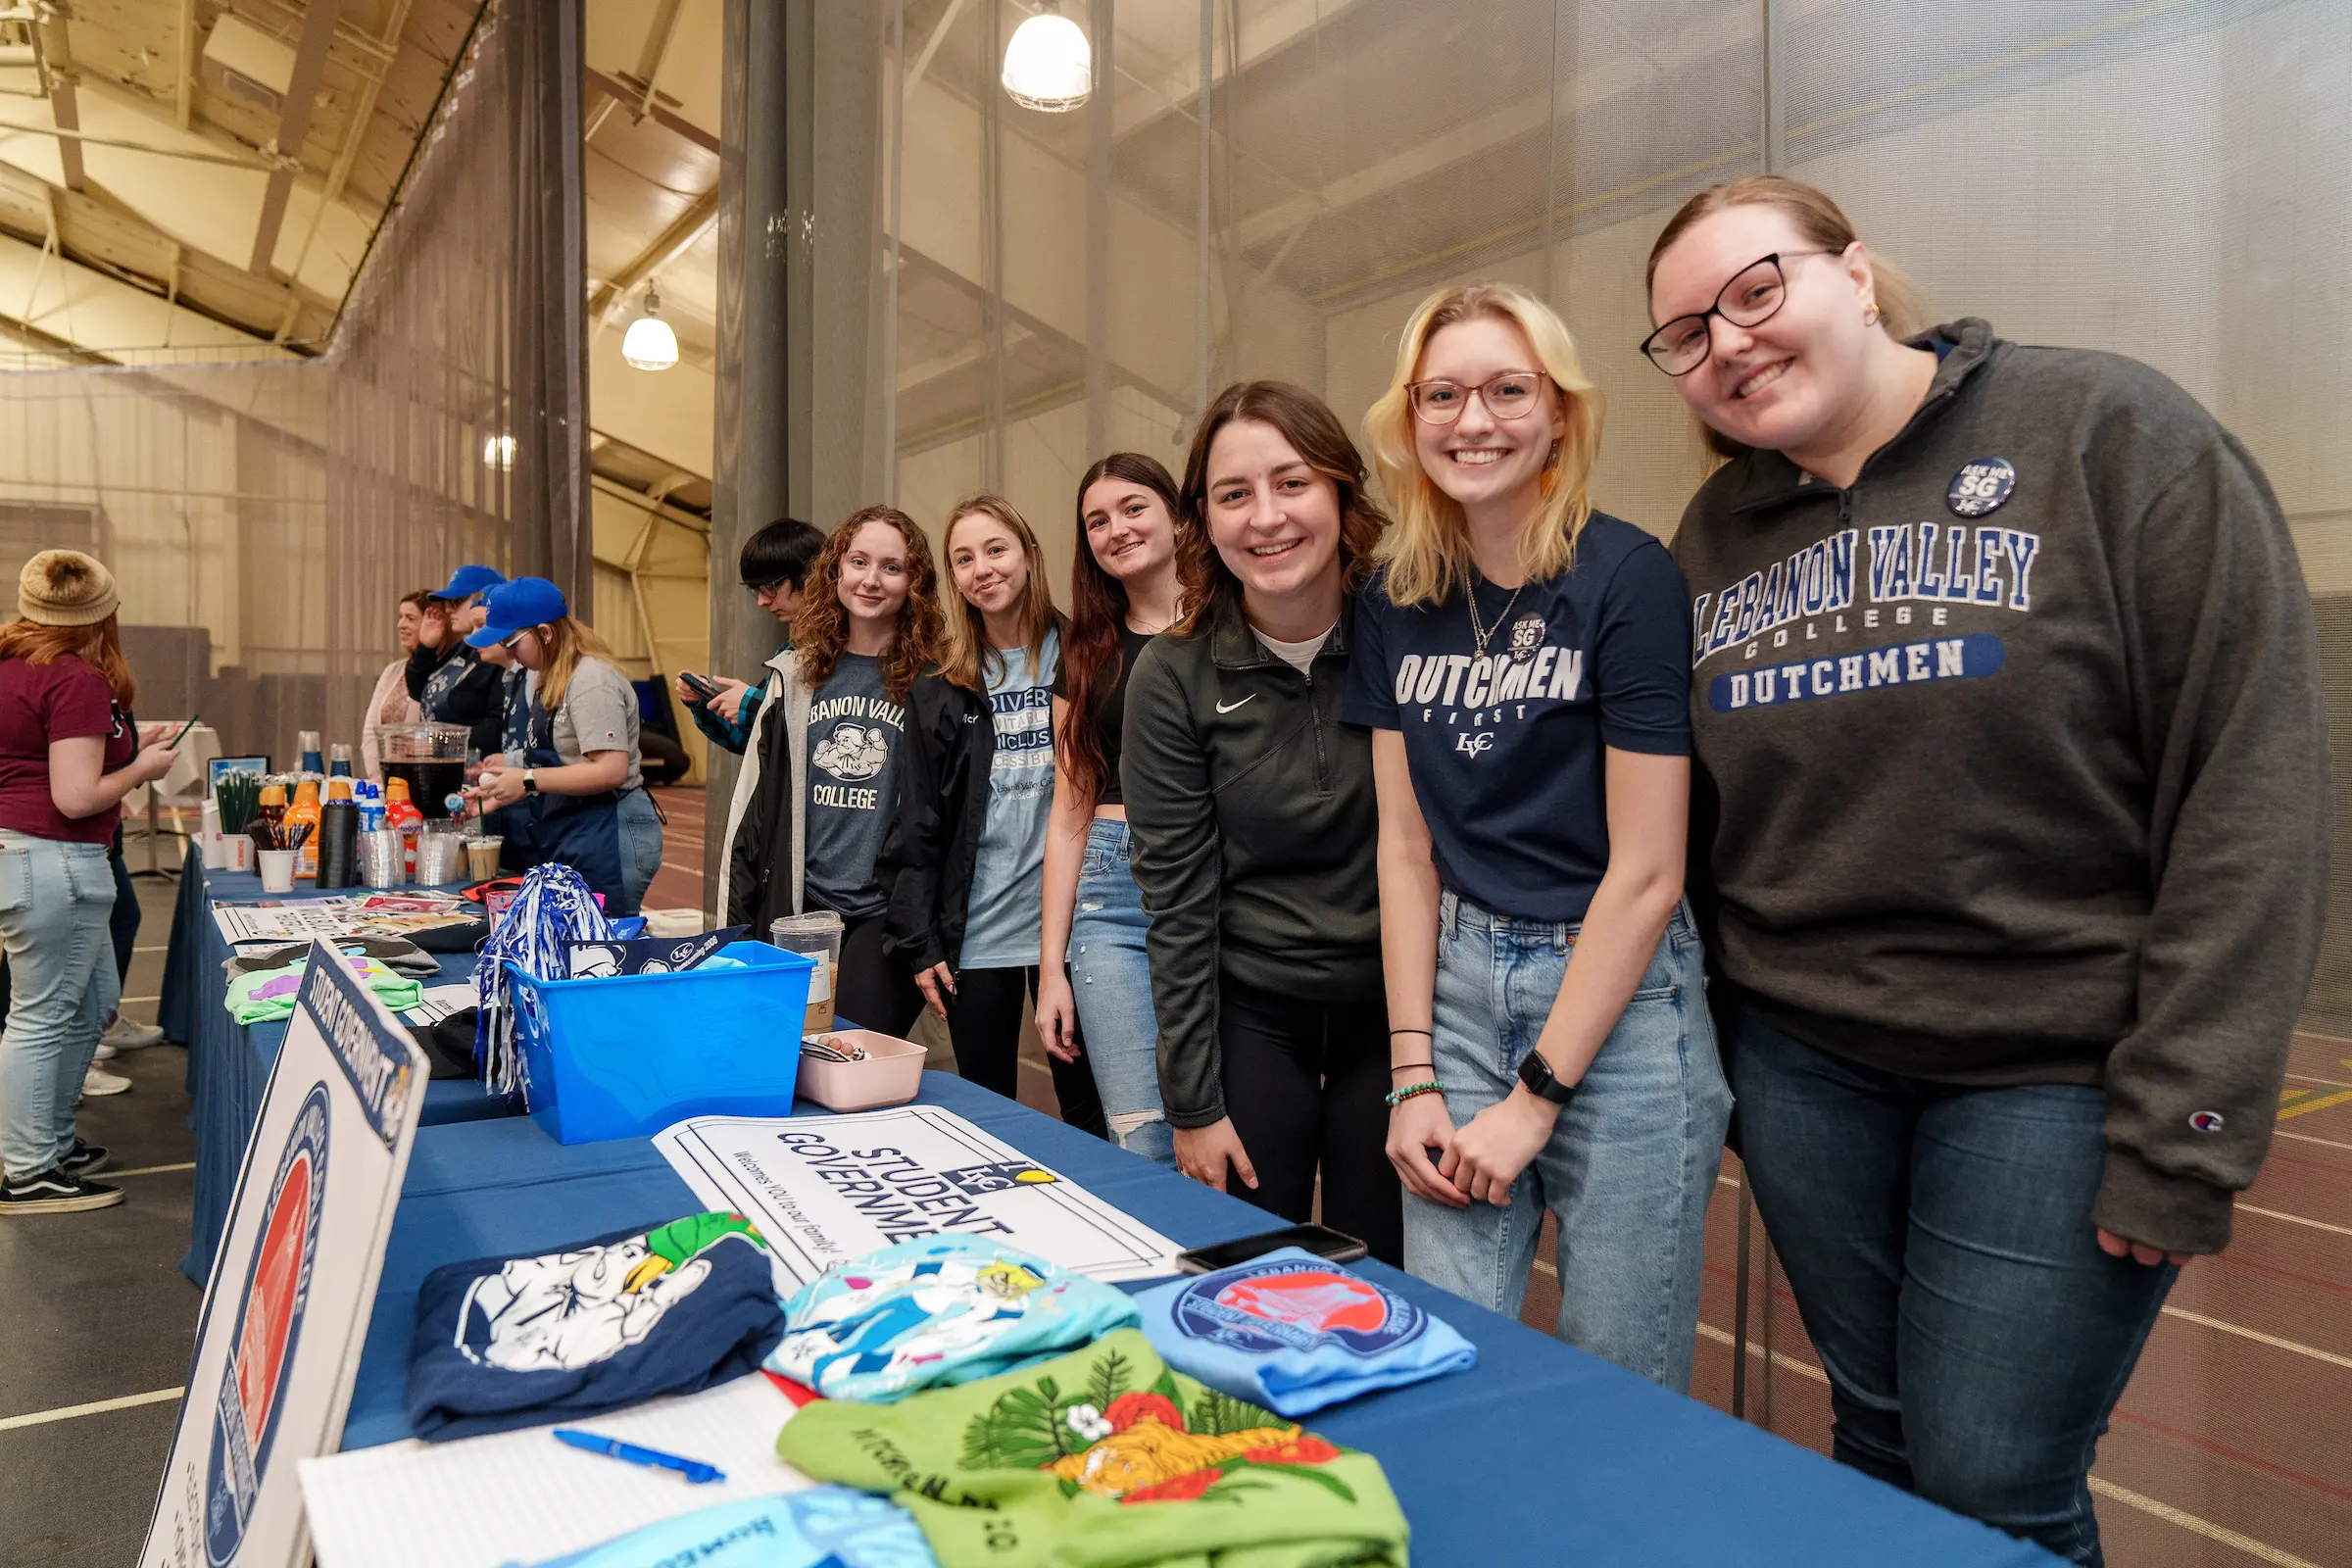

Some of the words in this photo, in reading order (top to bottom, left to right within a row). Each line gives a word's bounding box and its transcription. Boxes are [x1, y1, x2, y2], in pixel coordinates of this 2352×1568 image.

[1959, 475, 1999, 497] SG
[1692, 529, 1858, 669] LEBANON
[1868, 522, 2039, 612] VALLEY
[1512, 620, 1529, 630] ASK
[1528, 619, 1540, 628] ME
[1512, 628, 1535, 647] SG
[1744, 608, 1948, 660] COLLEGE
[1396, 647, 1583, 709] DUTCHMEN
[1730, 639, 1965, 709] DUTCHMEN
[808, 696, 866, 726] BANON
[868, 699, 906, 733] VALL
[1423, 705, 1526, 726] FIRST
[996, 731, 1050, 750] NCLUS
[994, 752, 1054, 767] CESSIBL
[813, 784, 878, 809] COLLEGE
[310, 965, 343, 1032] STUDENT
[733, 1151, 772, 1185] Welcomes
[764, 1184, 795, 1200] YOU
[777, 1133, 940, 1245] GOVERNME
[852, 1148, 1015, 1235] STUDENT
[778, 1200, 798, 1209] to
[788, 1210, 810, 1223] our
[794, 1224, 843, 1253] family!
